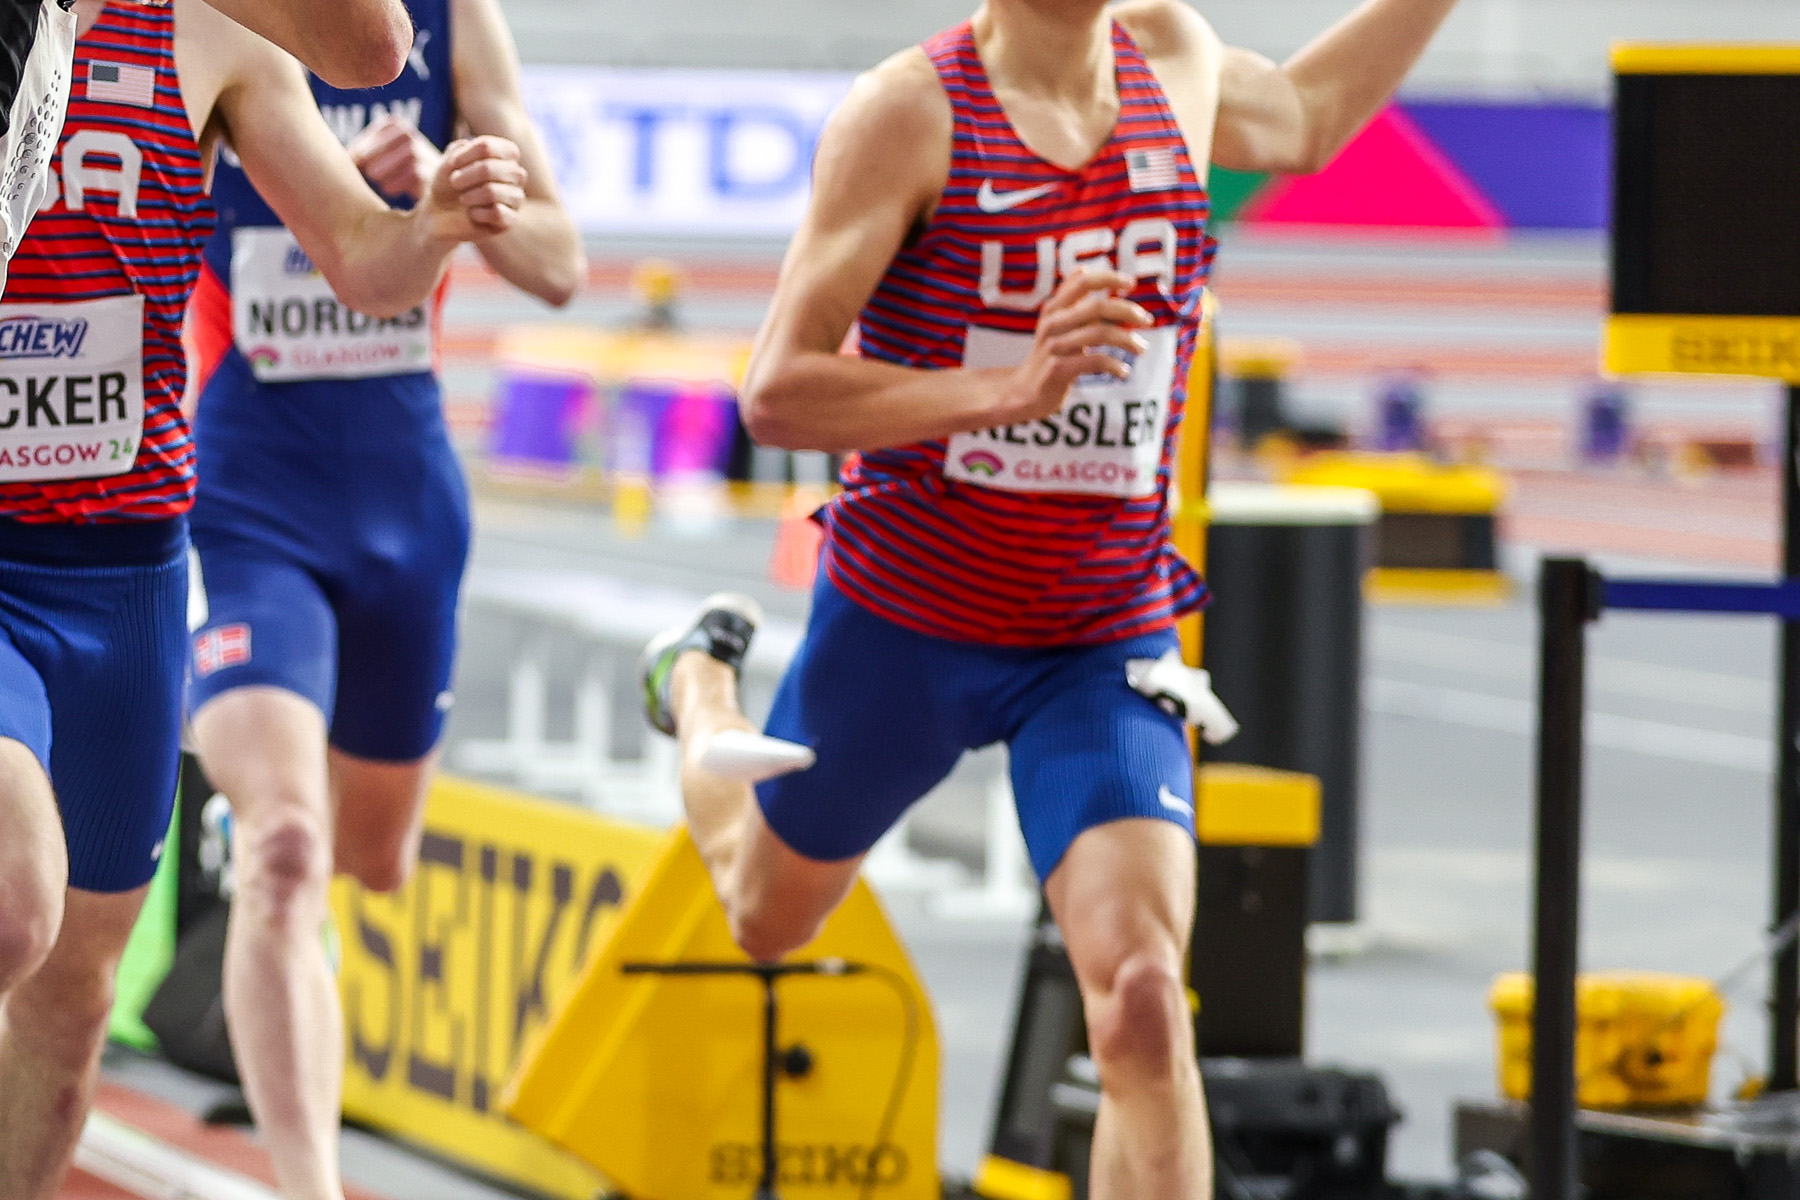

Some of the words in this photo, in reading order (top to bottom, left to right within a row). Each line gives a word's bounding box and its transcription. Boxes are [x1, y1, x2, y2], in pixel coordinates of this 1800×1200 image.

[978, 217, 1178, 310] USA
[109, 439, 133, 460] 24
[709, 1142, 912, 1186] SEIKO
